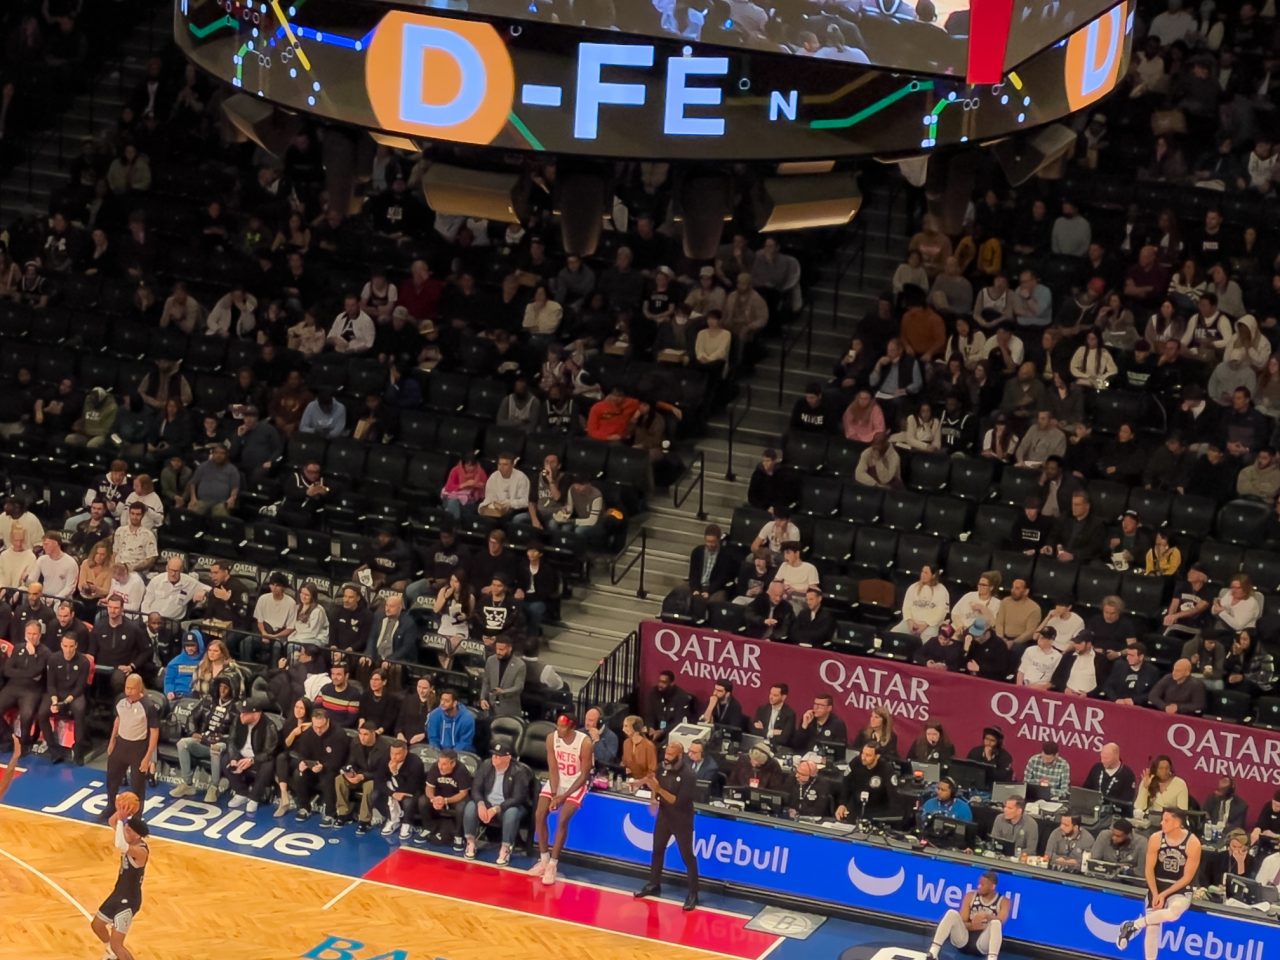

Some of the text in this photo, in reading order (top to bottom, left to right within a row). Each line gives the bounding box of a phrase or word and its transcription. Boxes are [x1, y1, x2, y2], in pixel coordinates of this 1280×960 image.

[801, 413, 824, 425] NIKE
[233, 563, 258, 574] QATAR
[423, 634, 446, 646] QATAR
[460, 640, 485, 652] QATAR
[654, 628, 761, 671] QATAR
[680, 661, 761, 688] AIRWAYS
[819, 659, 930, 704] QATAR
[845, 691, 929, 722] AIRWAYS
[991, 691, 1105, 735] QATAR
[1017, 722, 1105, 752] AIRWAYS
[1167, 723, 1280, 767] QATAR
[557, 751, 576, 764] NETS
[1194, 755, 1280, 785] AIRWAYS
[692, 830, 789, 874] Webull
